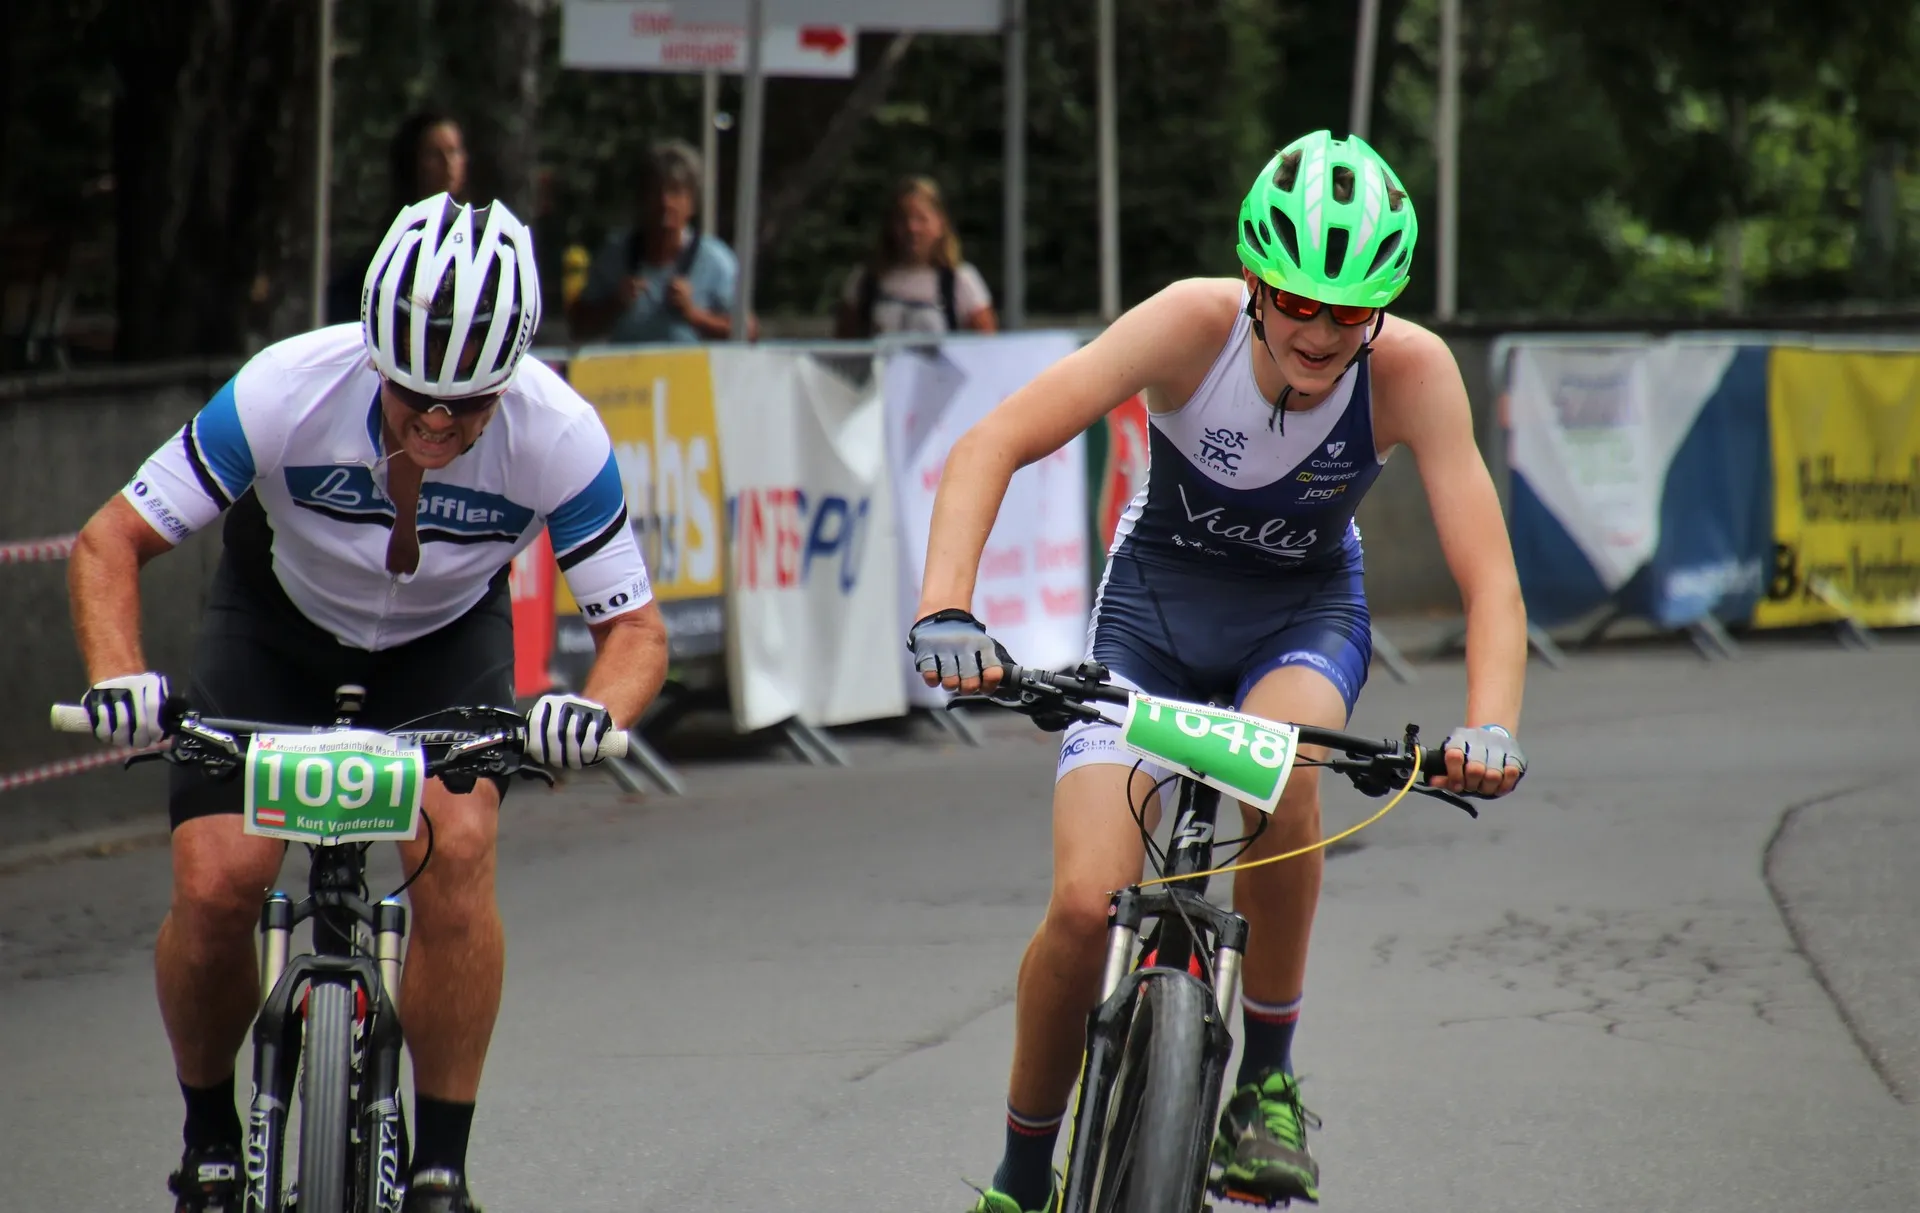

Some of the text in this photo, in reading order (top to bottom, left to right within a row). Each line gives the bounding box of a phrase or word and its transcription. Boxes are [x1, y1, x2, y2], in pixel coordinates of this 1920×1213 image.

[1199, 439, 1242, 471] TAC
[1193, 453, 1237, 477] COLMAR
[1311, 459, 1354, 469] Colmar
[1312, 470, 1360, 482] INVERSE
[1178, 484, 1318, 549] Vialis
[276, 741, 415, 757] Montafon Mountainbike Marathon
[1075, 739, 1116, 751] COLMA
[262, 753, 404, 809] 1091
[296, 815, 324, 832] Kurt
[327, 816, 395, 832] Vonderleu
